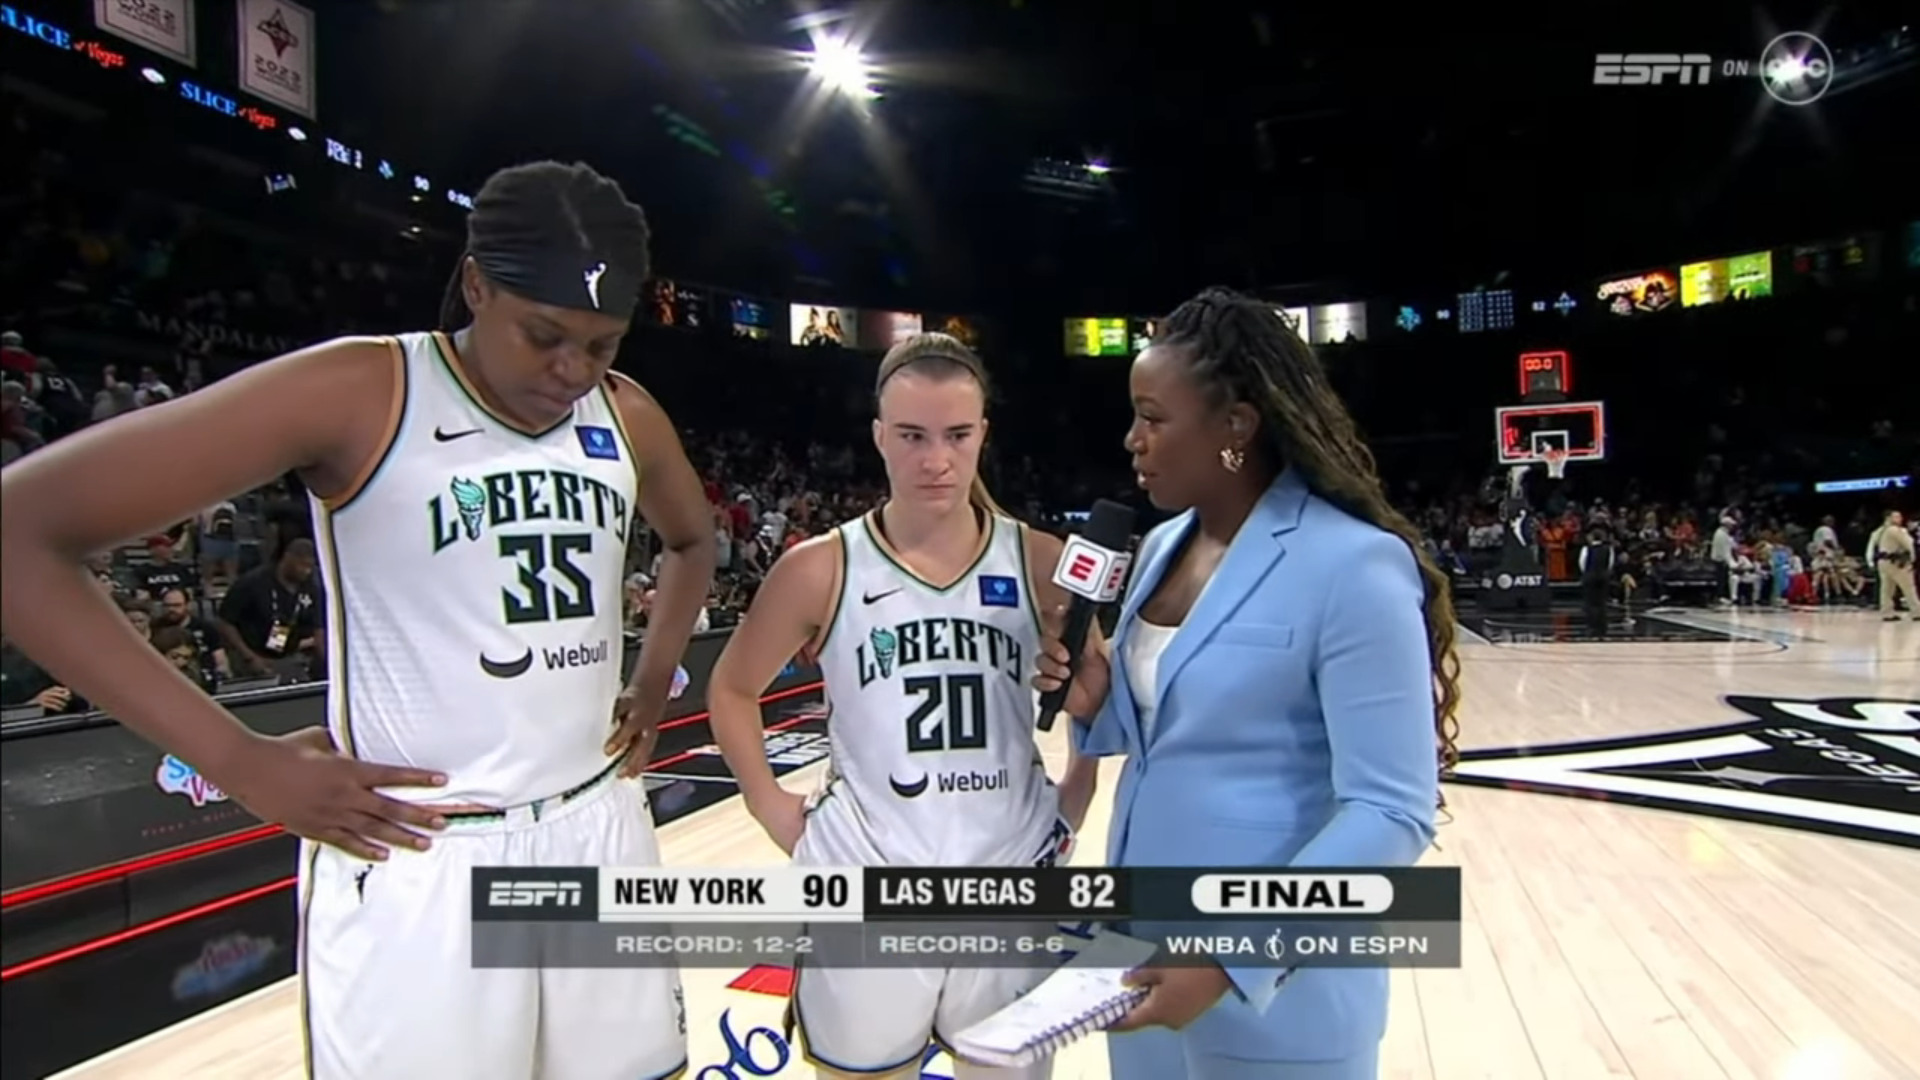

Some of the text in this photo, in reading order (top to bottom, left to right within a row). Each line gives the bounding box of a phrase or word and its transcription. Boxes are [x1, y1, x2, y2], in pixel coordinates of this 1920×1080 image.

[181, 82, 238, 117] SLICE
[499, 533, 595, 625] 35
[542, 640, 608, 670] Webull
[903, 674, 987, 753] 20
[937, 769, 1010, 793] Webull
